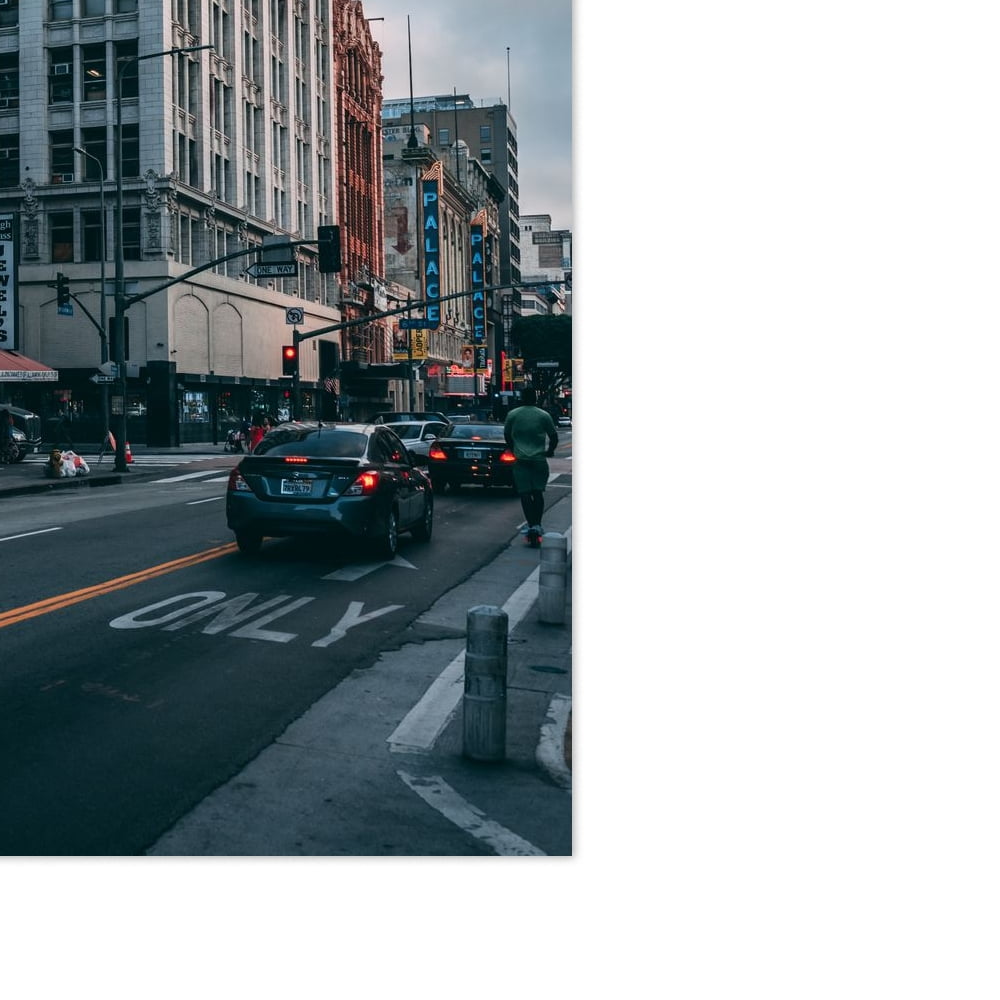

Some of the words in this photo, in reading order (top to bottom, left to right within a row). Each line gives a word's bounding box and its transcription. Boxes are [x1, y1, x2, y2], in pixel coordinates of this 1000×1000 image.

[257, 265, 273, 274] ONE
[276, 264, 293, 274] WAY
[423, 192, 439, 321] PALACE
[471, 234, 484, 338] PALACE
[109, 590, 406, 647] ONLY
